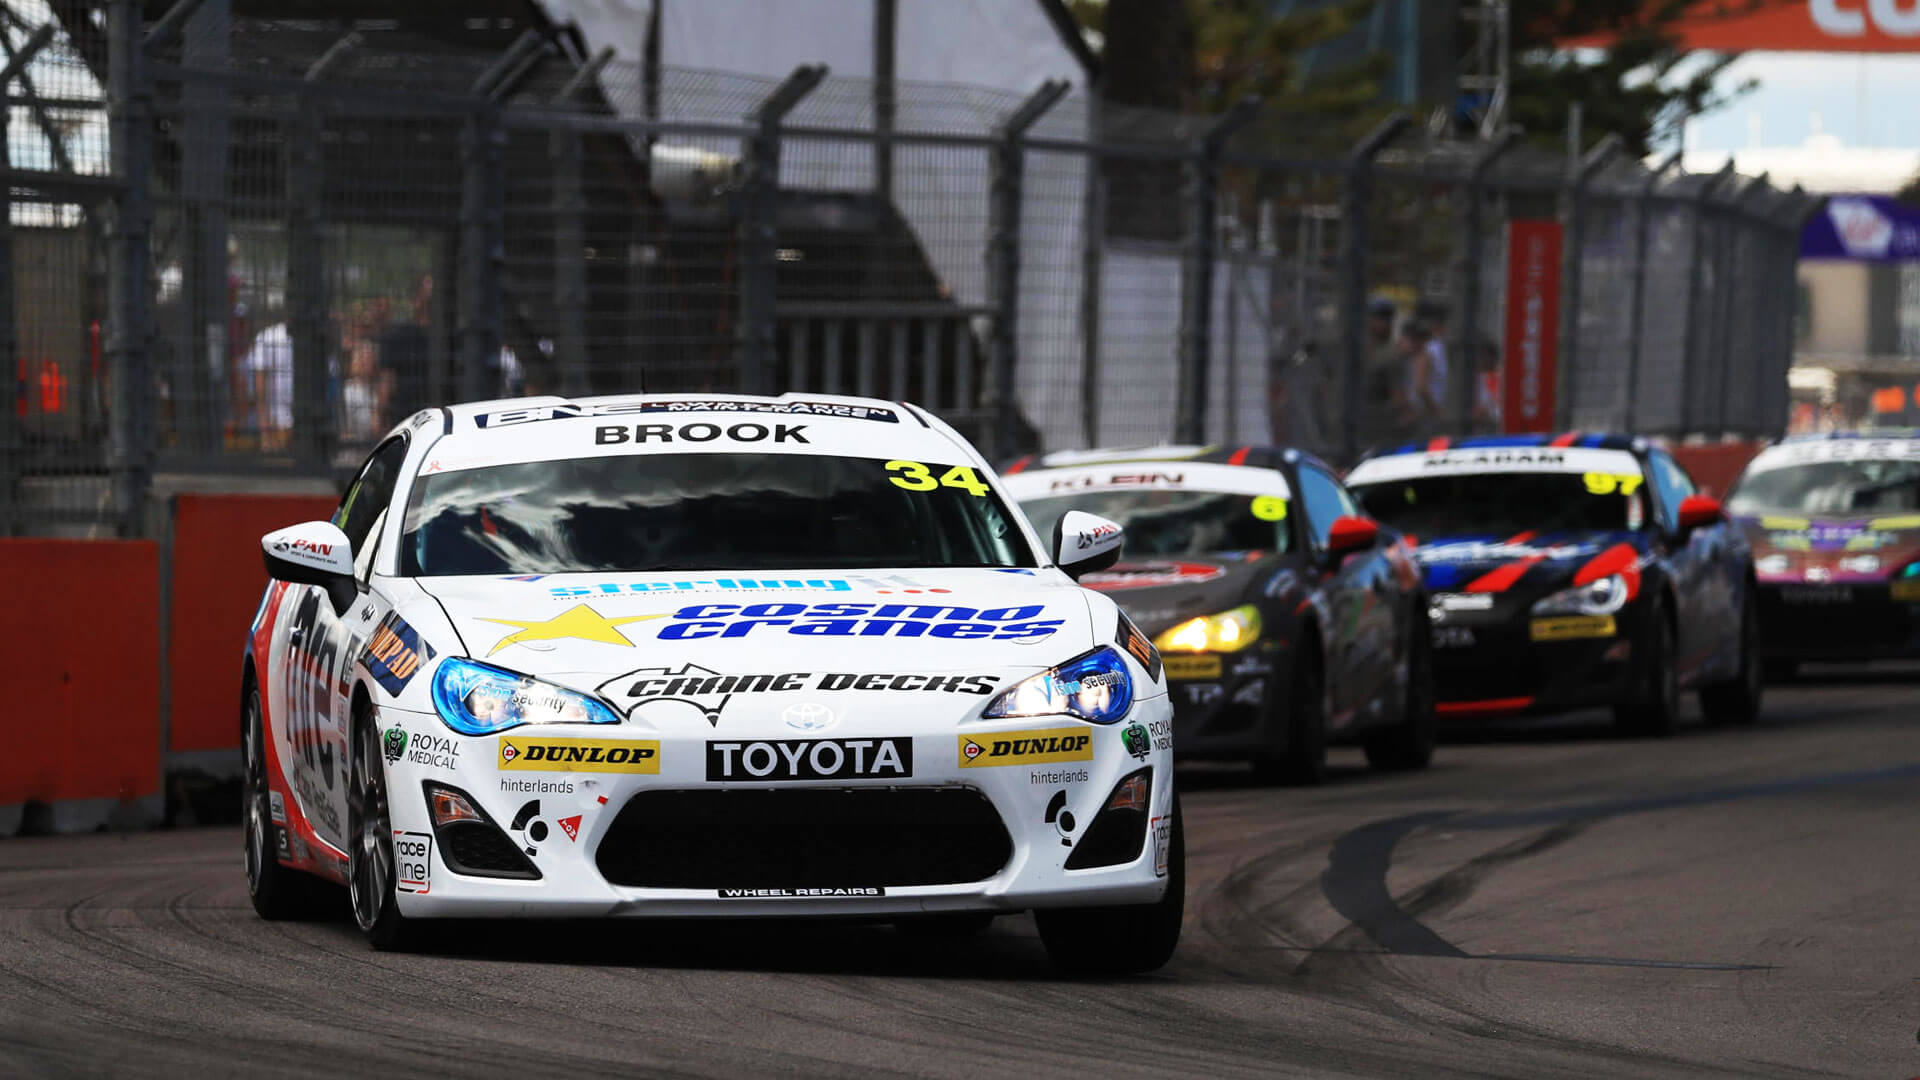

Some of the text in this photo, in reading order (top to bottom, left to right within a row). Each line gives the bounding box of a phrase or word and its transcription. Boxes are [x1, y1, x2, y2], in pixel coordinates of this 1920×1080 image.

[594, 423, 813, 446] BROOK
[885, 459, 989, 498] 34
[1583, 472, 1644, 496] 97
[291, 538, 333, 556] PAN
[549, 578, 853, 597] sterling
[674, 602, 1046, 621] cosmo
[656, 616, 1066, 641] cranes
[626, 672, 1001, 698] CRANE DECKS
[410, 733, 460, 757] ROYAL
[523, 745, 656, 764] DUNLOP
[989, 735, 1090, 757] DUNLOP
[407, 749, 457, 771] MEDICAL
[713, 740, 905, 777] TOYOTA
[500, 778, 574, 794] hinterlands
[1031, 769, 1089, 785] hinterlands
[396, 841, 426, 857] race
[724, 887, 879, 897] WHEEL REPAIRS
